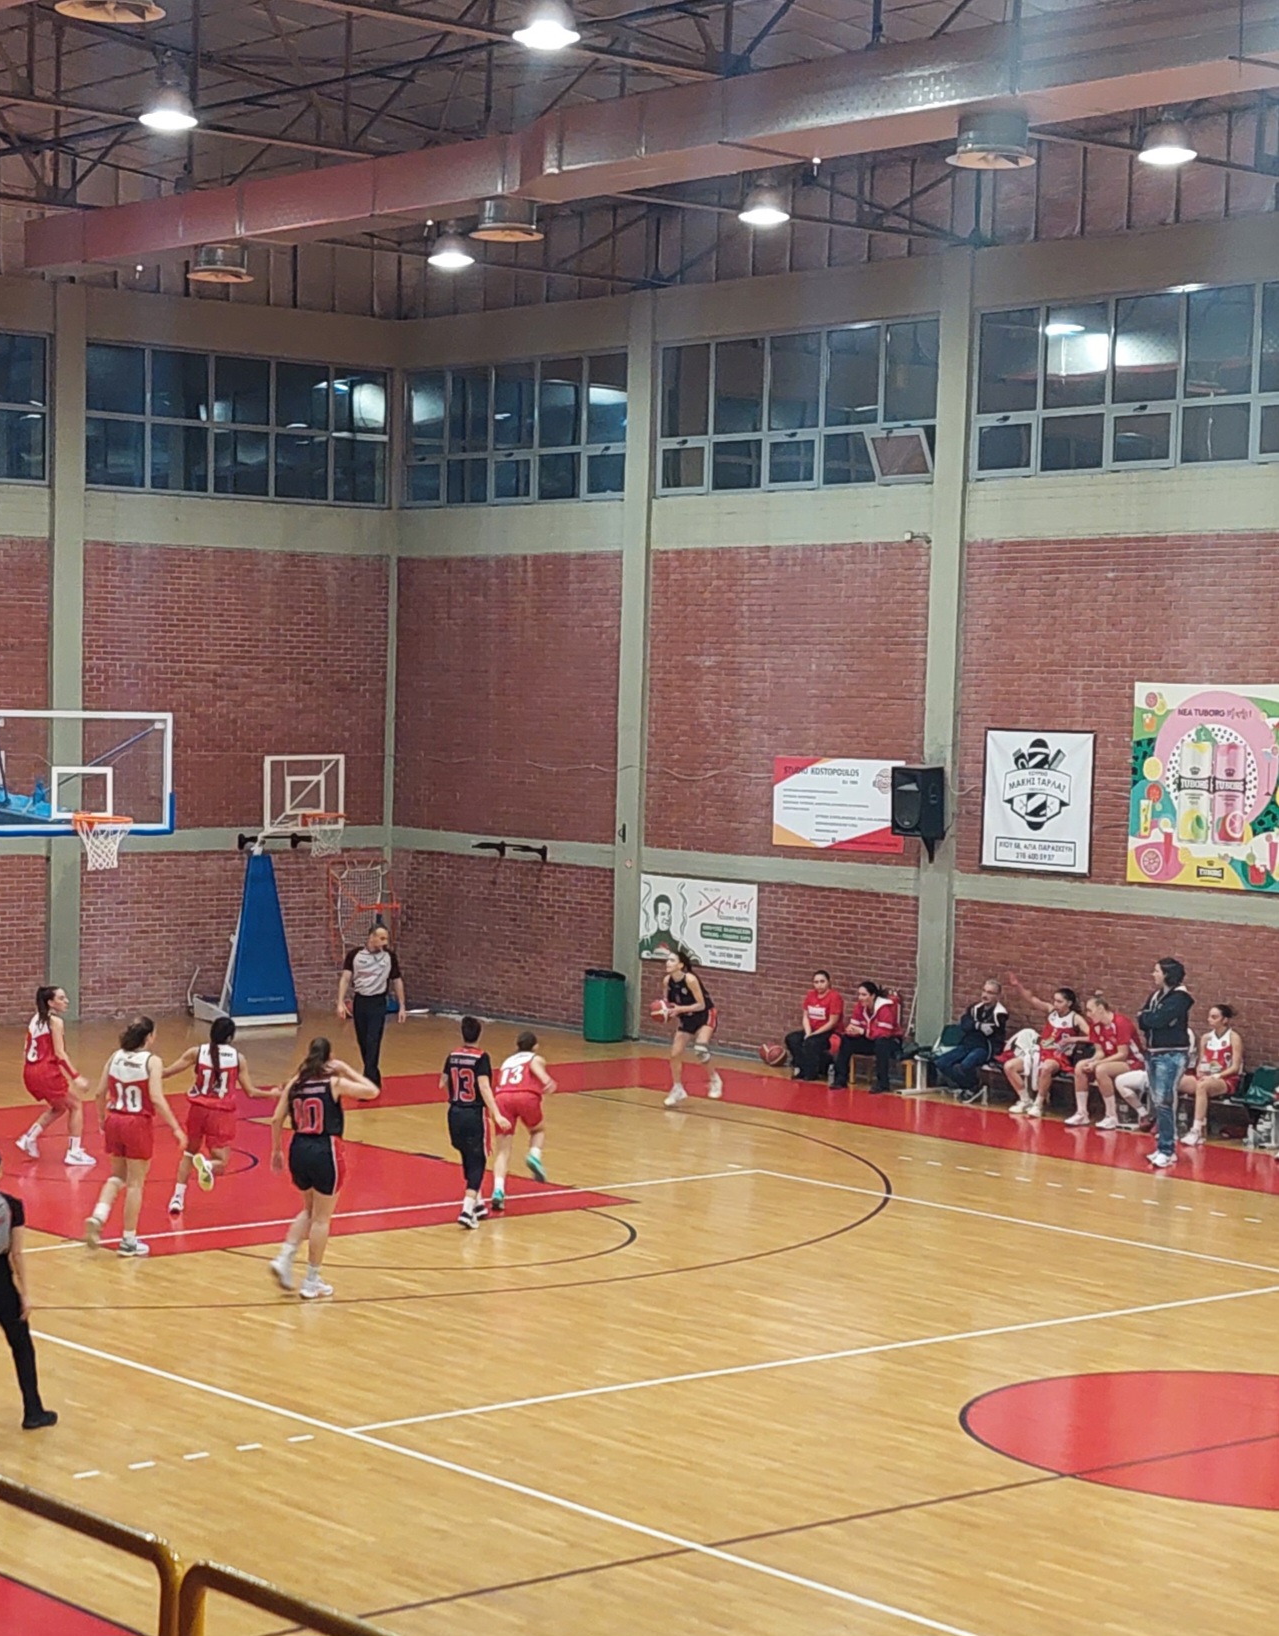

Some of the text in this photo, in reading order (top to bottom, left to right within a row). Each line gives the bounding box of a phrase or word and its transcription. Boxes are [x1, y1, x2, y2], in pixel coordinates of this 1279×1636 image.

[1194, 708, 1226, 718] TUBORG
[784, 766, 860, 777] STUDIO KOSTOPOULOS
[450, 1067, 476, 1102] 13
[499, 1065, 524, 1086] 13
[115, 1082, 142, 1112] 10
[293, 1097, 324, 1135] 10
